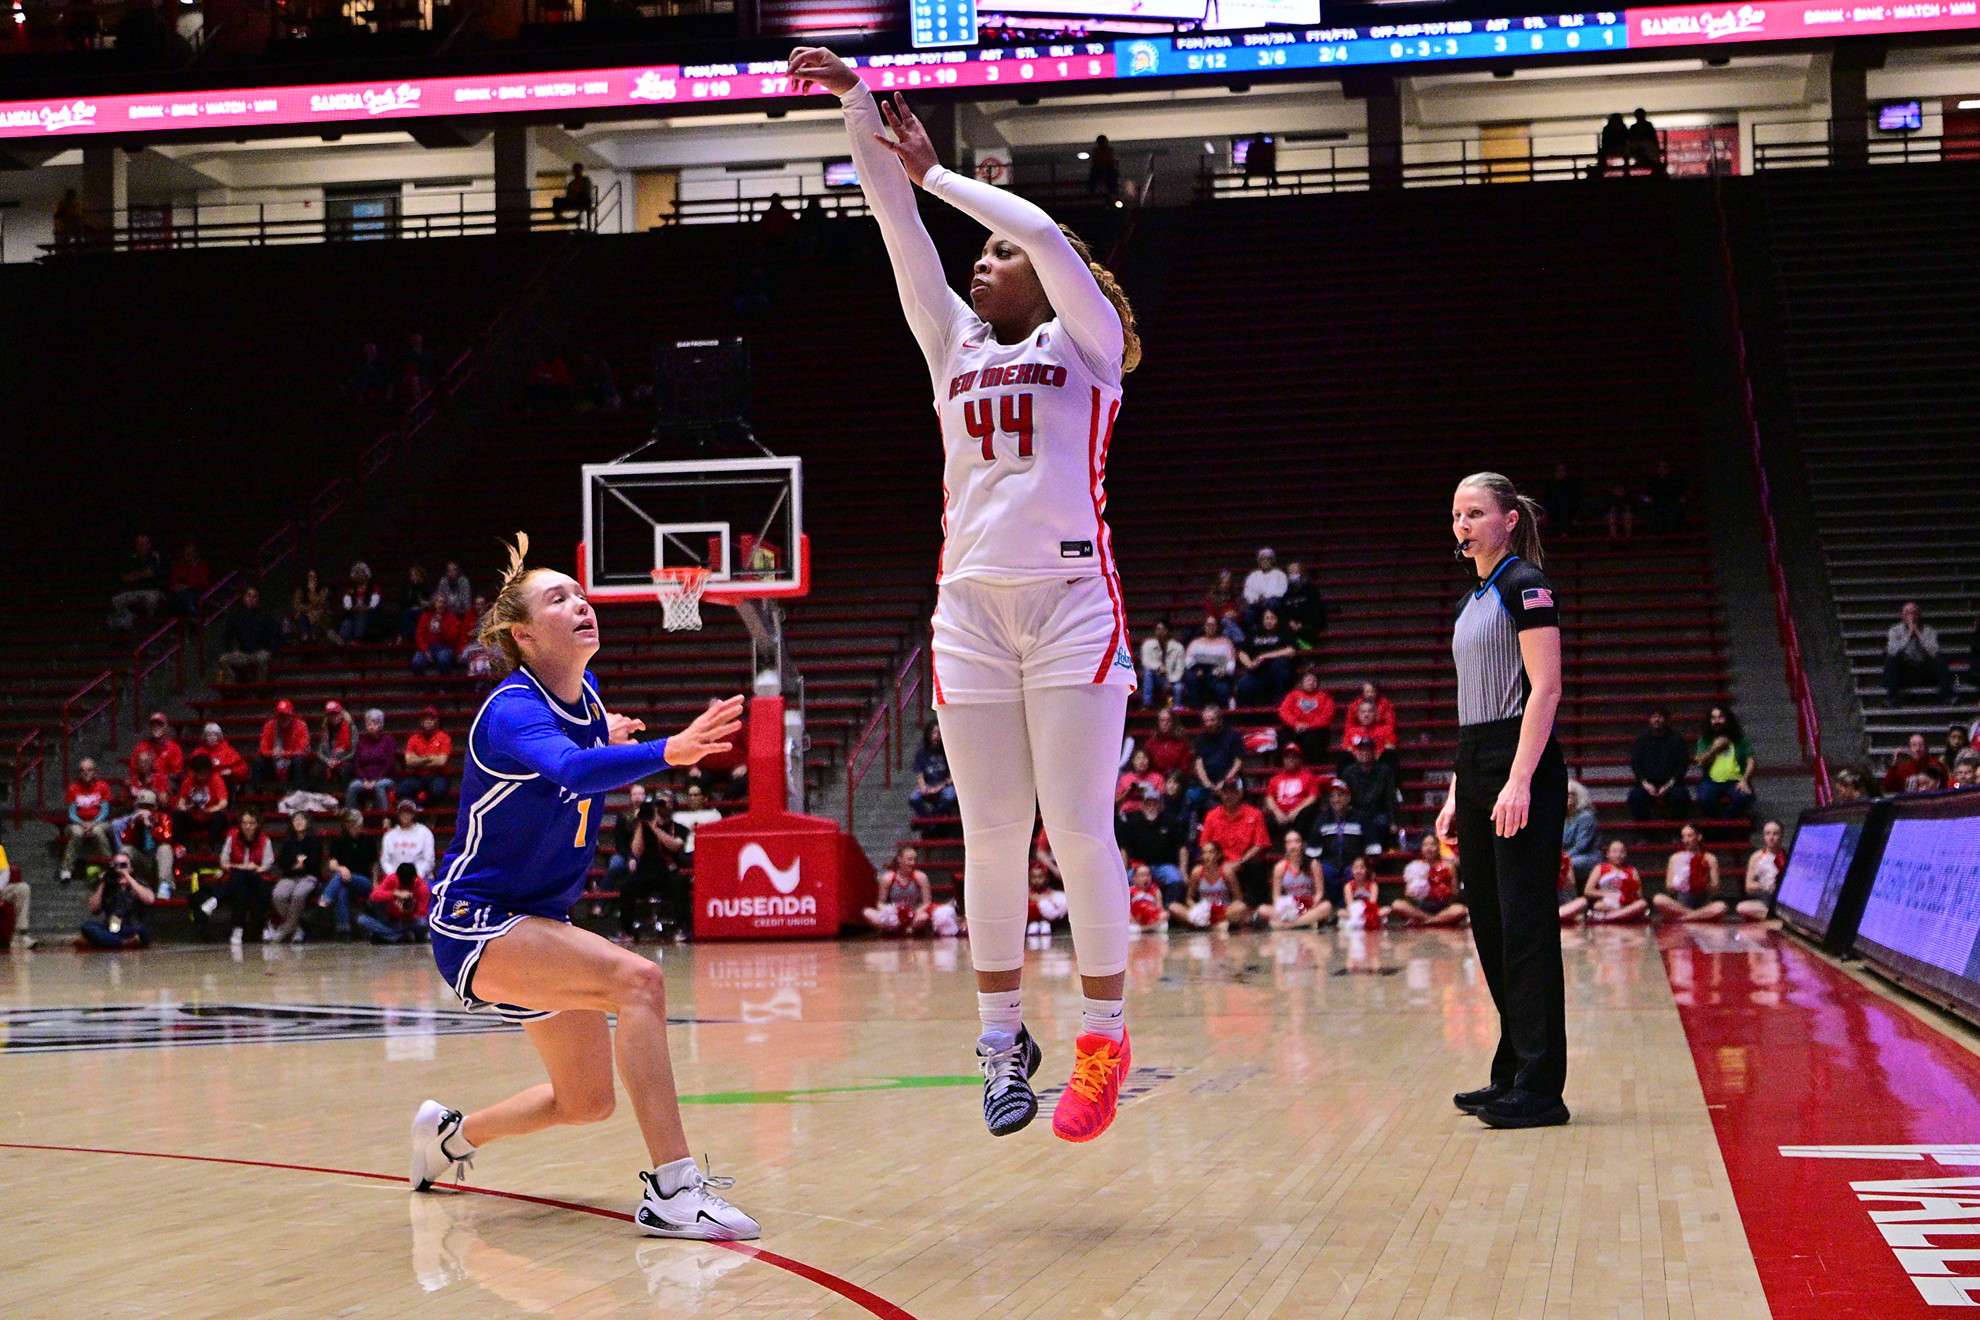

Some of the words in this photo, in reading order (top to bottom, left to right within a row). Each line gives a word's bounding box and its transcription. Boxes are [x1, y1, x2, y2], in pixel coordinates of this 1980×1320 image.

[1804, 10, 1845, 24] DRINK
[1853, 7, 1884, 22] DINE
[1894, 4, 1940, 19] WATCH
[1950, 2, 1976, 16] WIN
[1306, 29, 1358, 42] FTM/FTA
[1597, 12, 1616, 25] TO
[1641, 18, 1701, 36] SANDIA
[1188, 54, 1227, 70] 5/12
[1258, 50, 1286, 66] 3/6
[1319, 46, 1348, 63] 2/4
[1495, 36, 1508, 52] 3
[1567, 32, 1579, 48] 0
[1604, 30, 1614, 46] 1
[1058, 62, 1068, 77] 1
[454, 88, 491, 102] DRINK
[534, 83, 576, 98] WATCH
[584, 82, 608, 95] WIN
[129, 106, 164, 120] DRINK
[206, 102, 246, 115] WATCH
[254, 100, 278, 112] WIN
[310, 94, 363, 112] SANDIA
[0, 110, 40, 127] ANDIA
[948, 370, 978, 401] NEW
[980, 363, 1068, 388] MEXICO
[964, 393, 1034, 462] 44
[574, 798, 592, 848] 1
[707, 895, 816, 918] NUSENDA
[754, 917, 785, 928] CREDIT
[787, 916, 816, 926] UNION
